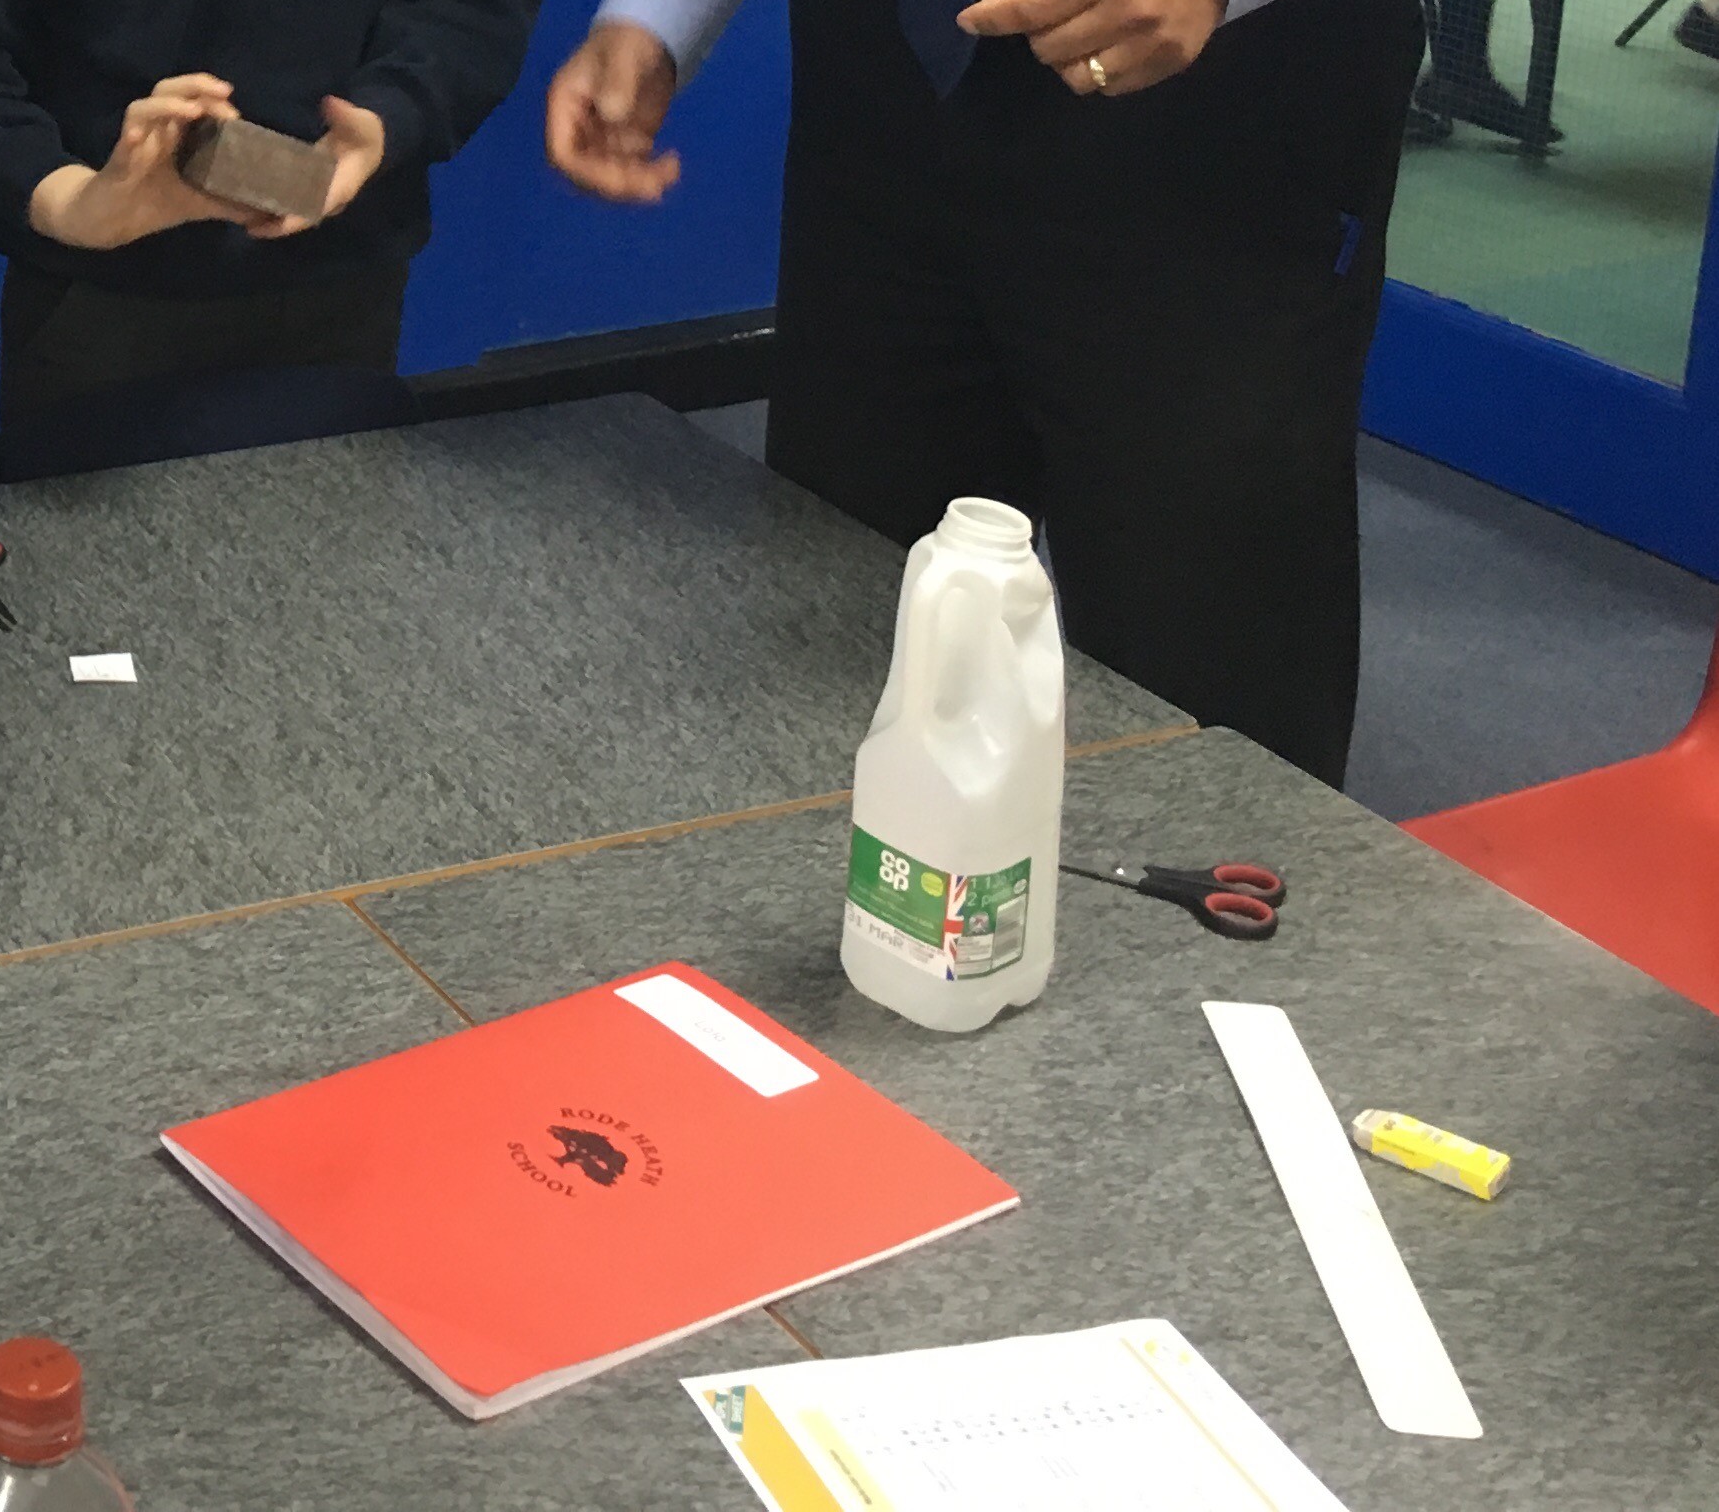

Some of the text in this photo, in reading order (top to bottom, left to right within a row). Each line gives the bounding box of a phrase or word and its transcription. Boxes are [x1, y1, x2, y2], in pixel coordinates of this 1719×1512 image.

[869, 923, 904, 949] MAR
[507, 1141, 577, 1198] SCHOOL
[560, 1107, 663, 1187] RODE HEATH
